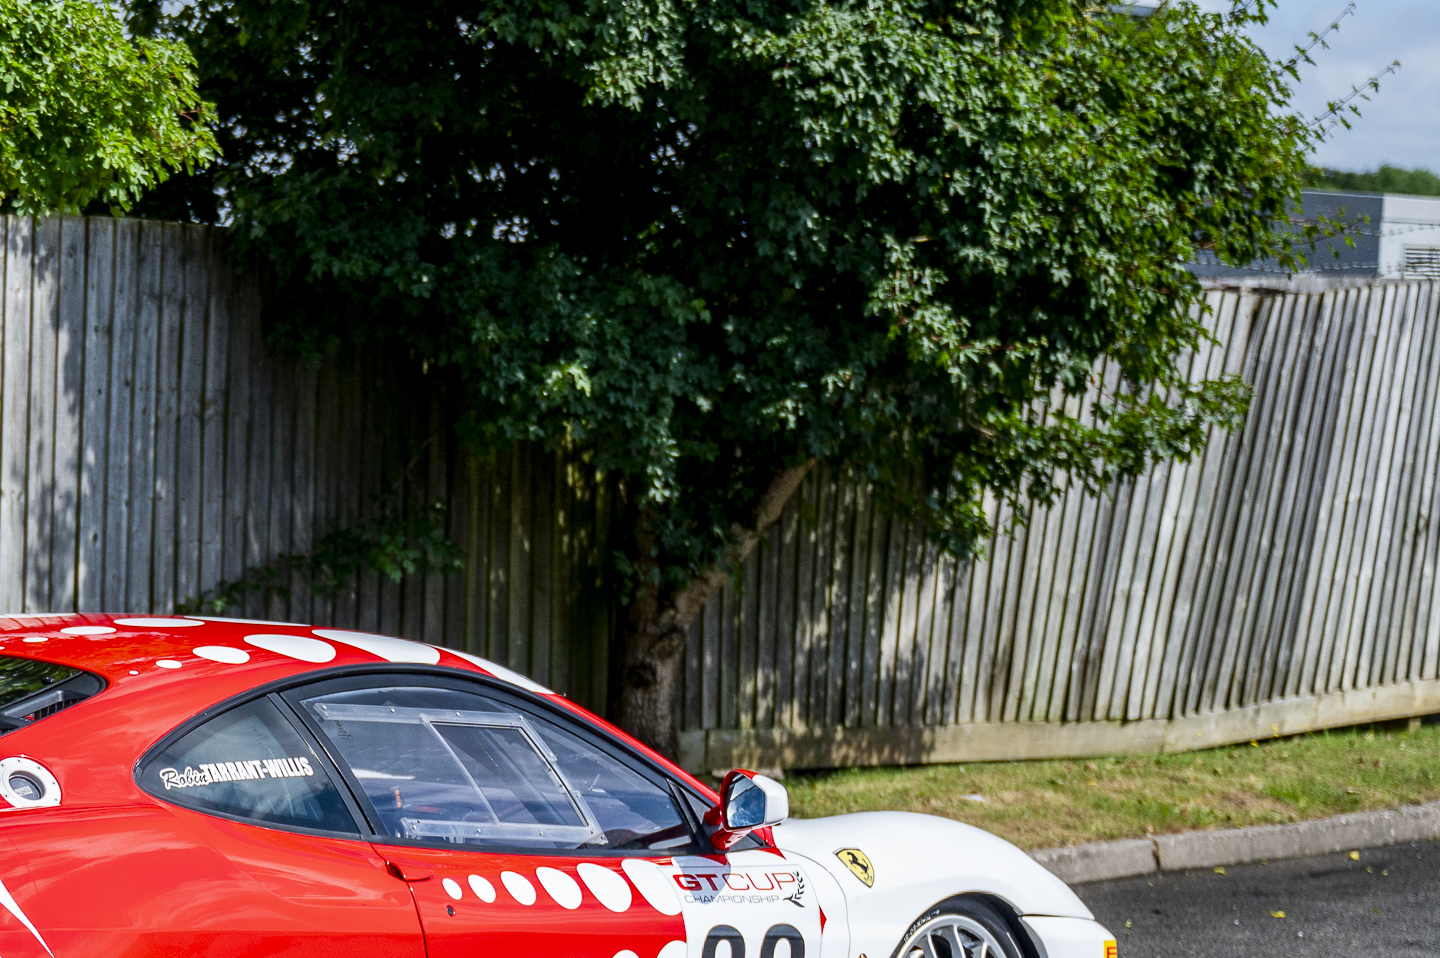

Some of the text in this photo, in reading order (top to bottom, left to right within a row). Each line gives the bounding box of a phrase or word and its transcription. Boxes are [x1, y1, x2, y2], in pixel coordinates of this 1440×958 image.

[160, 757, 314, 789] Robin TARRANT-WILLIS
[684, 895, 780, 904] CHAMPIONSHIP
